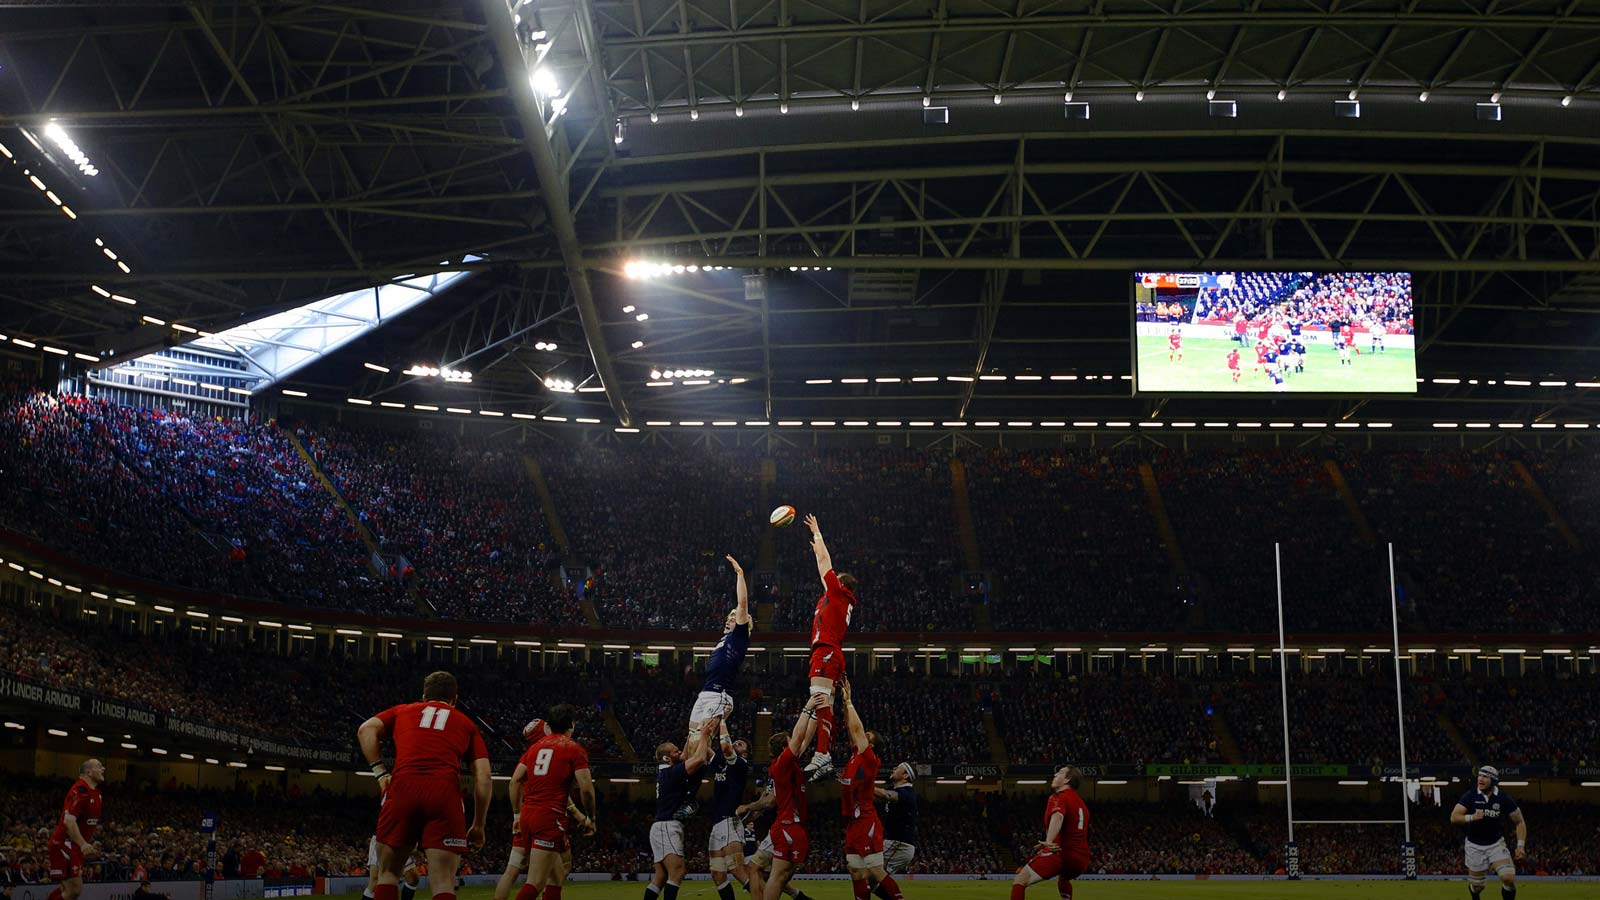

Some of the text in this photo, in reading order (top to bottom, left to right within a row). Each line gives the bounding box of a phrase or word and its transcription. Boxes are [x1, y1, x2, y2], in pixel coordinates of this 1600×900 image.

[12, 681, 81, 710] UNDER ARMOUR
[101, 702, 156, 727] UNDER ARMOUR
[419, 706, 451, 731] 11
[533, 748, 554, 776] 9
[954, 764, 997, 776] GUINNESS
[1170, 766, 1223, 775] GILBERT
[1271, 766, 1323, 776] GIBERT
[1077, 807, 1084, 830] 1
[1289, 857, 1299, 877] RBS
[1406, 857, 1417, 878] RBS
